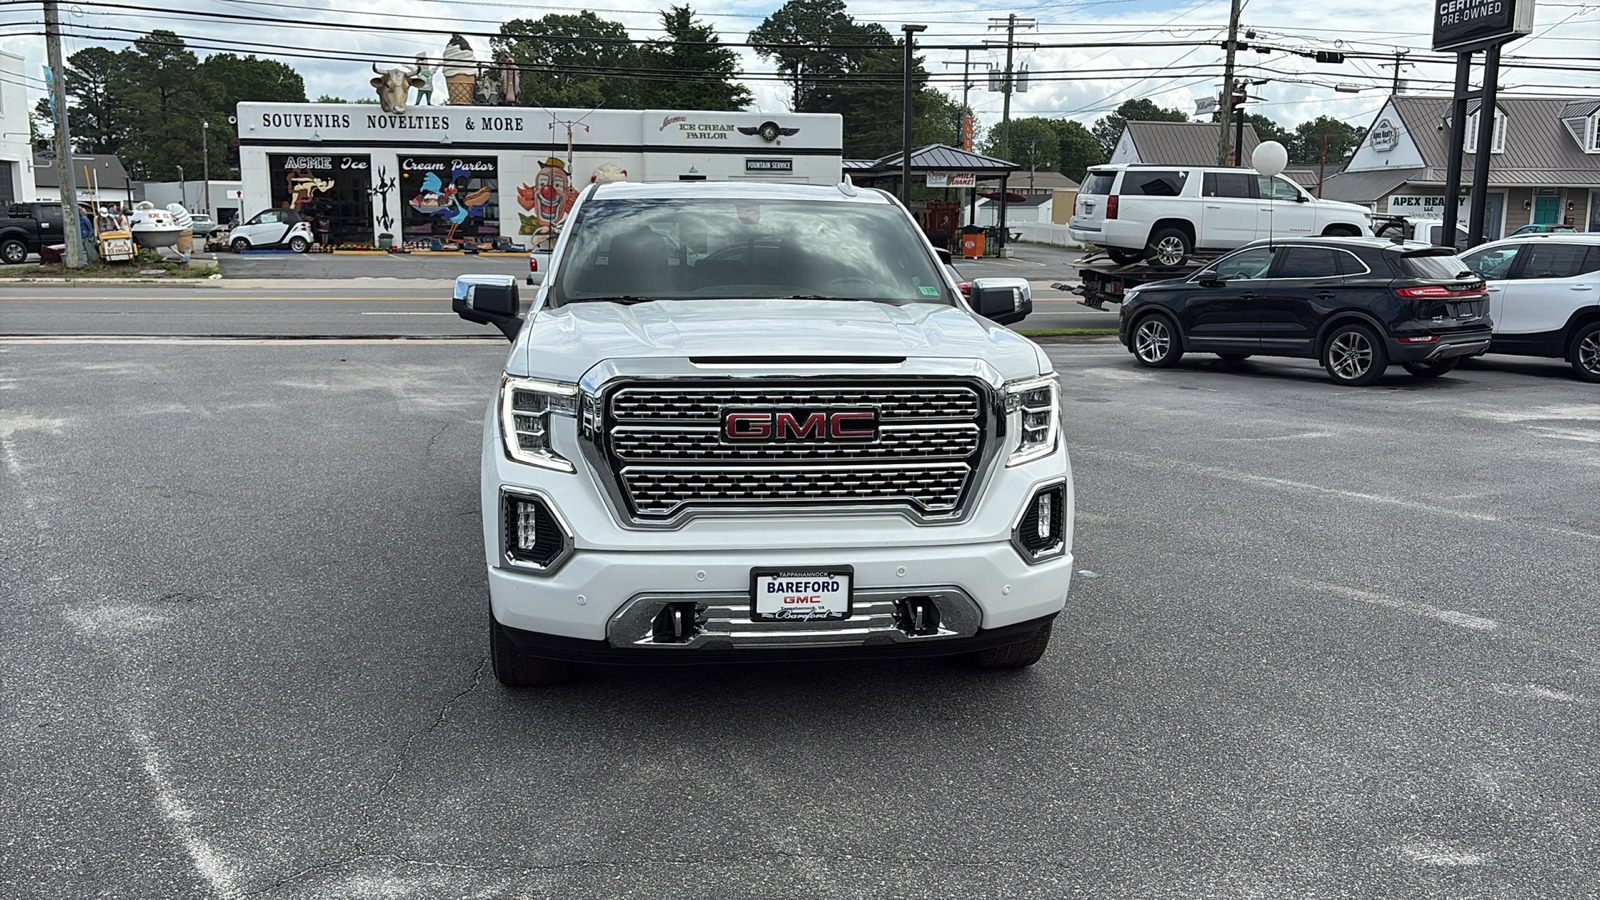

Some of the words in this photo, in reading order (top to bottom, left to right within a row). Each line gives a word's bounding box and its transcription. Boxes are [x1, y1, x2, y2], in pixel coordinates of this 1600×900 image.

[1441, 1, 1502, 27] PRE-OWNED
[263, 113, 351, 129] SOUVENIRS
[367, 114, 450, 130] NOVELTIES
[465, 117, 476, 131] &
[481, 117, 524, 131] MORE
[679, 123, 696, 131] ICE
[698, 124, 736, 132] CREAM
[686, 132, 728, 140] PARLOR
[284, 156, 332, 170] ACME
[340, 157, 369, 170] Ice
[402, 158, 446, 171] Cream
[451, 159, 495, 171] Parlor
[747, 161, 771, 169] FOUNTAIN
[771, 161, 791, 169] SERVICE
[1393, 196, 1422, 206] APEX
[1424, 196, 1466, 206] REAY
[726, 412, 876, 440] GMC
[767, 581, 840, 594] BAREFORD
[783, 595, 821, 604] GMC
[775, 609, 832, 622] Bareford
